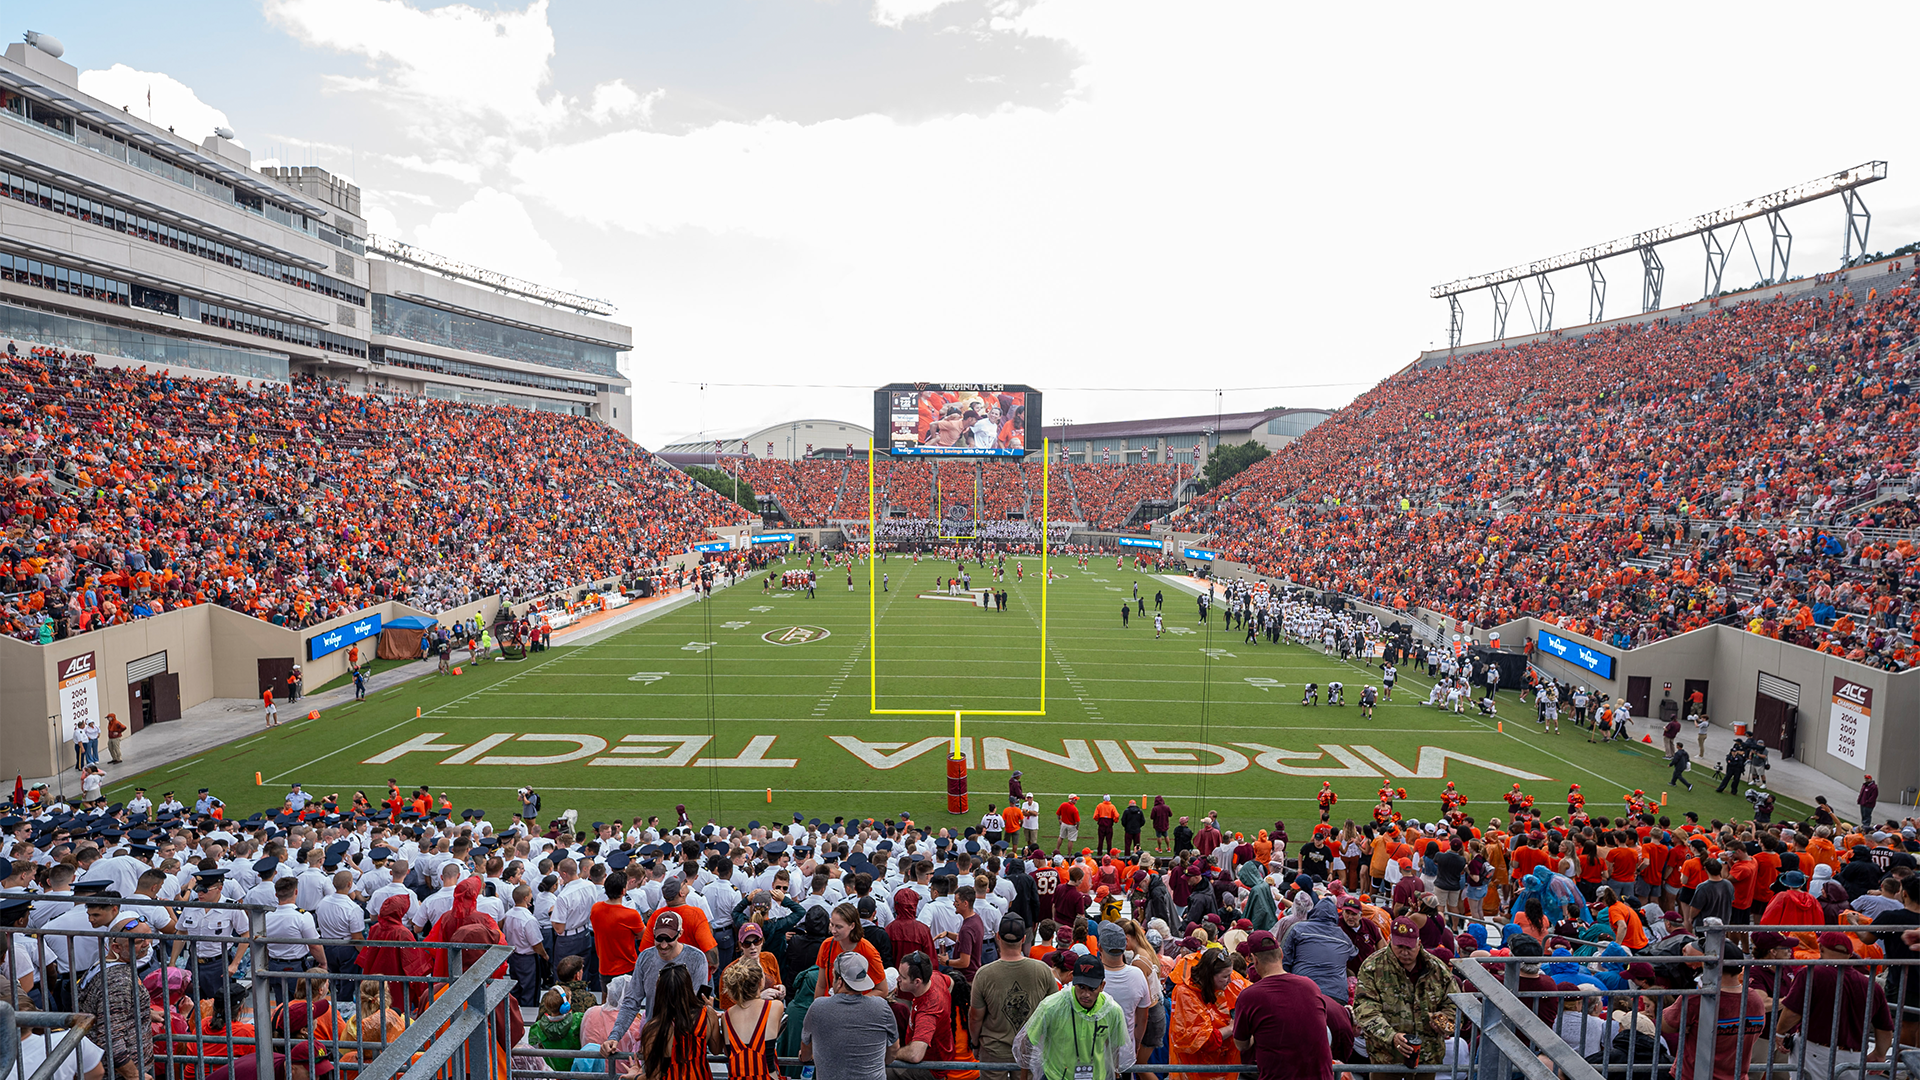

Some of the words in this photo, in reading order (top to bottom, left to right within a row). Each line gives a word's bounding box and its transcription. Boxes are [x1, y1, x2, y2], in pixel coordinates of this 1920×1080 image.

[914, 382, 930, 390] VT
[940, 383, 980, 391] VIRGINIA
[354, 621, 372, 636] Kroger
[323, 632, 342, 647] Kroger
[1548, 636, 1567, 655] Kroger
[64, 654, 92, 676] ACC
[1579, 648, 1598, 669] Kroger
[65, 673, 90, 687] CHAMPIONS
[72, 687, 87, 699] 2004
[1838, 683, 1868, 702] ACC
[72, 698, 87, 710] 2007
[1837, 698, 1862, 714] CHAMPIONS
[73, 708, 88, 720] 2008
[1841, 713, 1857, 725] 2004
[1840, 724, 1857, 736] 2007
[1839, 734, 1855, 747] 2008
[358, 732, 800, 768] TECH
[1838, 744, 1854, 757] 2010
[828, 735, 1553, 781] VIRGINIA
[986, 819, 999, 829] 78
[1037, 876, 1057, 895] 93
[1080, 964, 1094, 973] VT
[1717, 1026, 1762, 1034] pataonia
